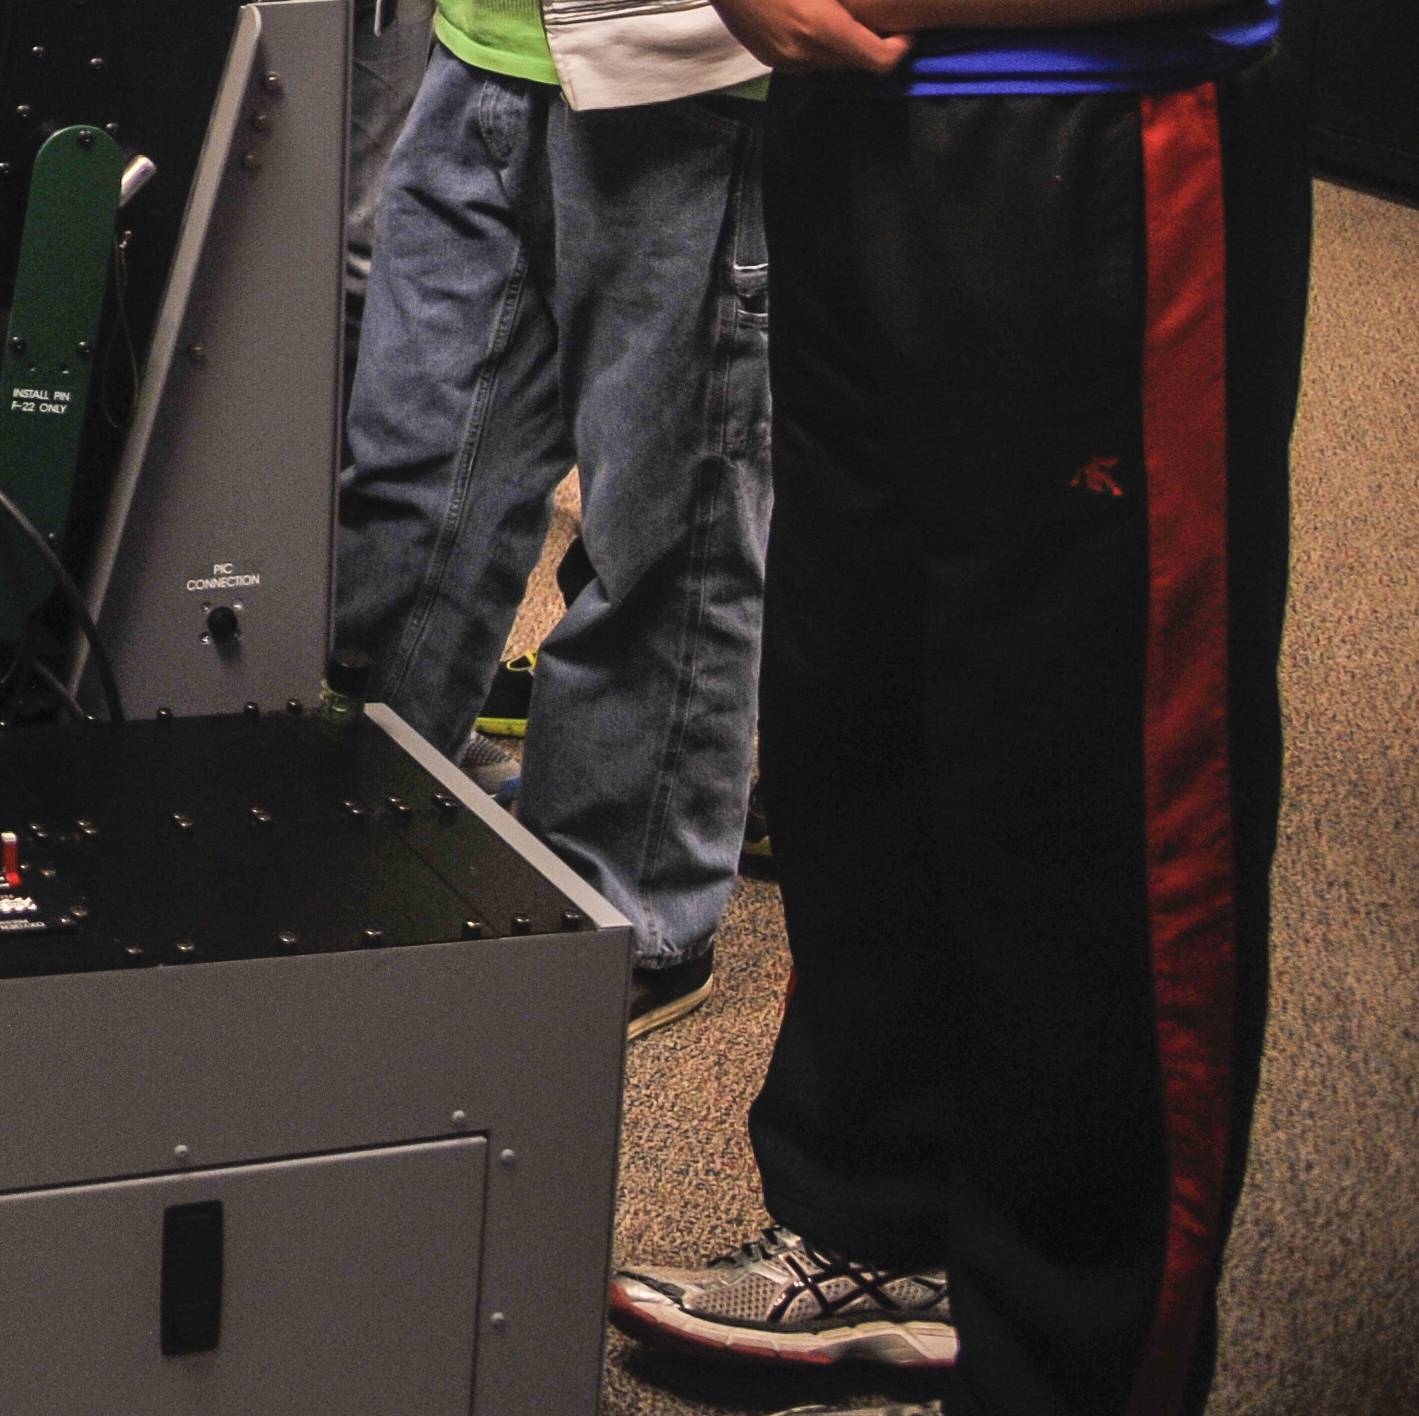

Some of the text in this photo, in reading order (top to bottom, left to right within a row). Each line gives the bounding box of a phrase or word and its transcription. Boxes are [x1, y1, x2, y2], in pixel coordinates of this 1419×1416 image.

[13, 388, 71, 401] INSTALL PIN
[11, 400, 67, 414] F-22 ONLY
[186, 563, 260, 591] PIC CONNECTION
